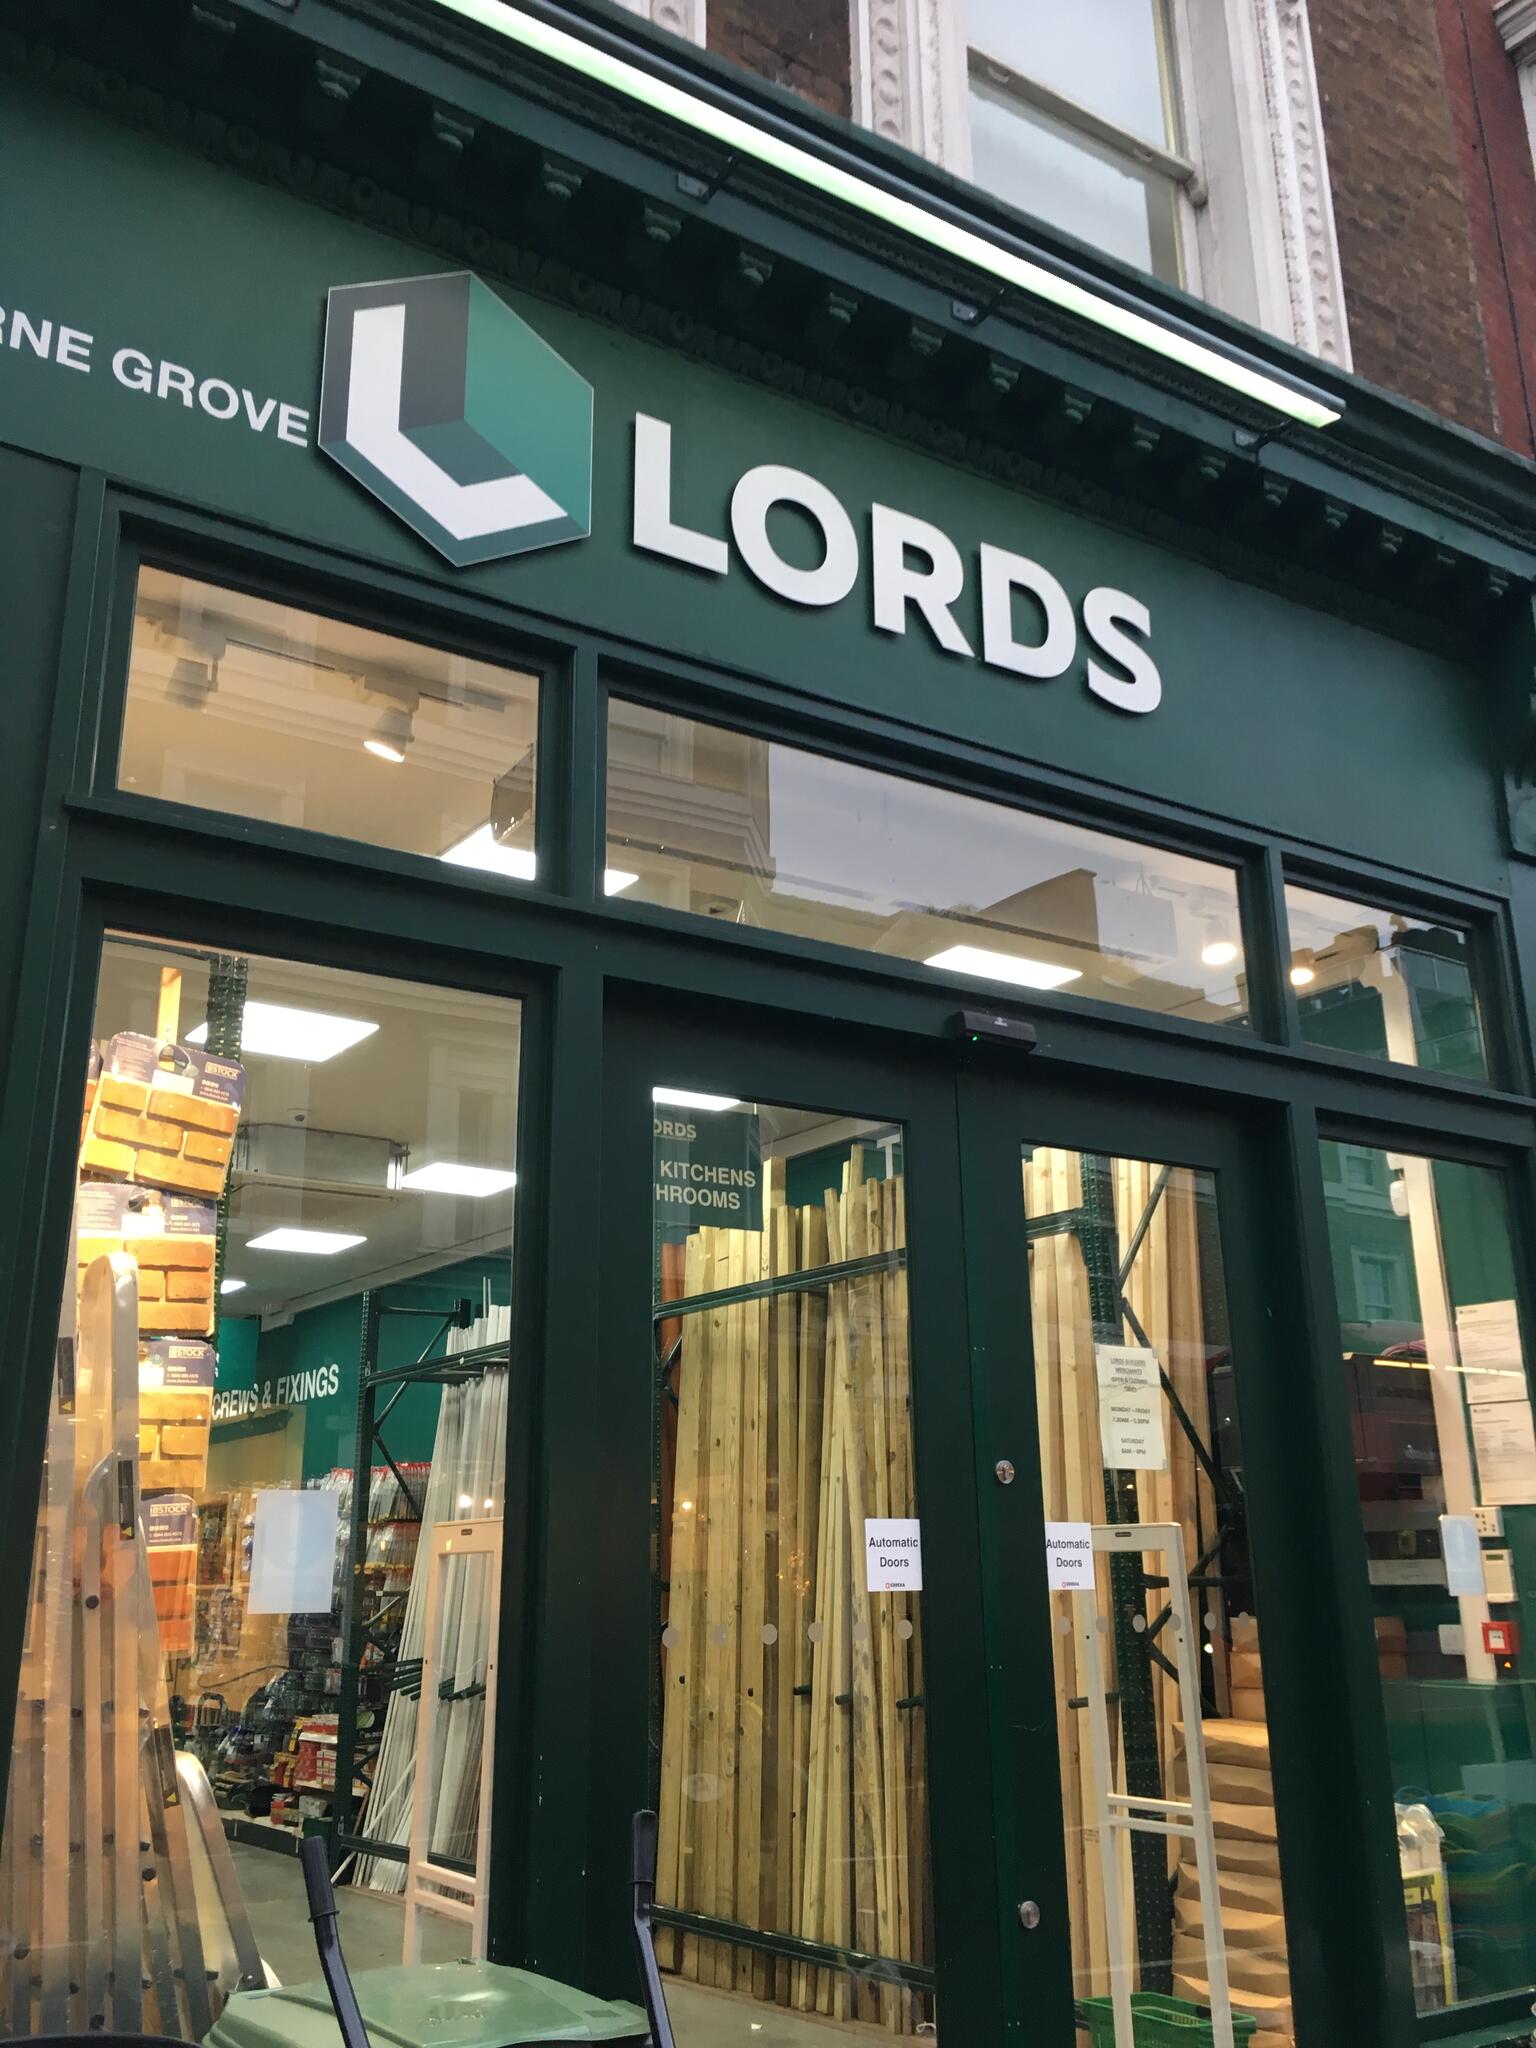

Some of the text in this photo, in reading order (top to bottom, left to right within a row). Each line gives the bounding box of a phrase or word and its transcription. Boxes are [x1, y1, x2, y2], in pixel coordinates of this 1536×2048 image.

[0, 306, 310, 448] NE GROVE
[633, 411, 1162, 714] LORDS
[660, 1160, 756, 1188] KITCHENS
[653, 1183, 741, 1210] HROOMS
[211, 1363, 339, 1421] CREWS & FIXINGS
[150, 1504, 188, 1515] IBSTOCK
[868, 1536, 919, 1547] Automatic
[1046, 1538, 1090, 1549] Automatic
[879, 1556, 910, 1567] Doors
[1056, 1557, 1083, 1568] Doors
